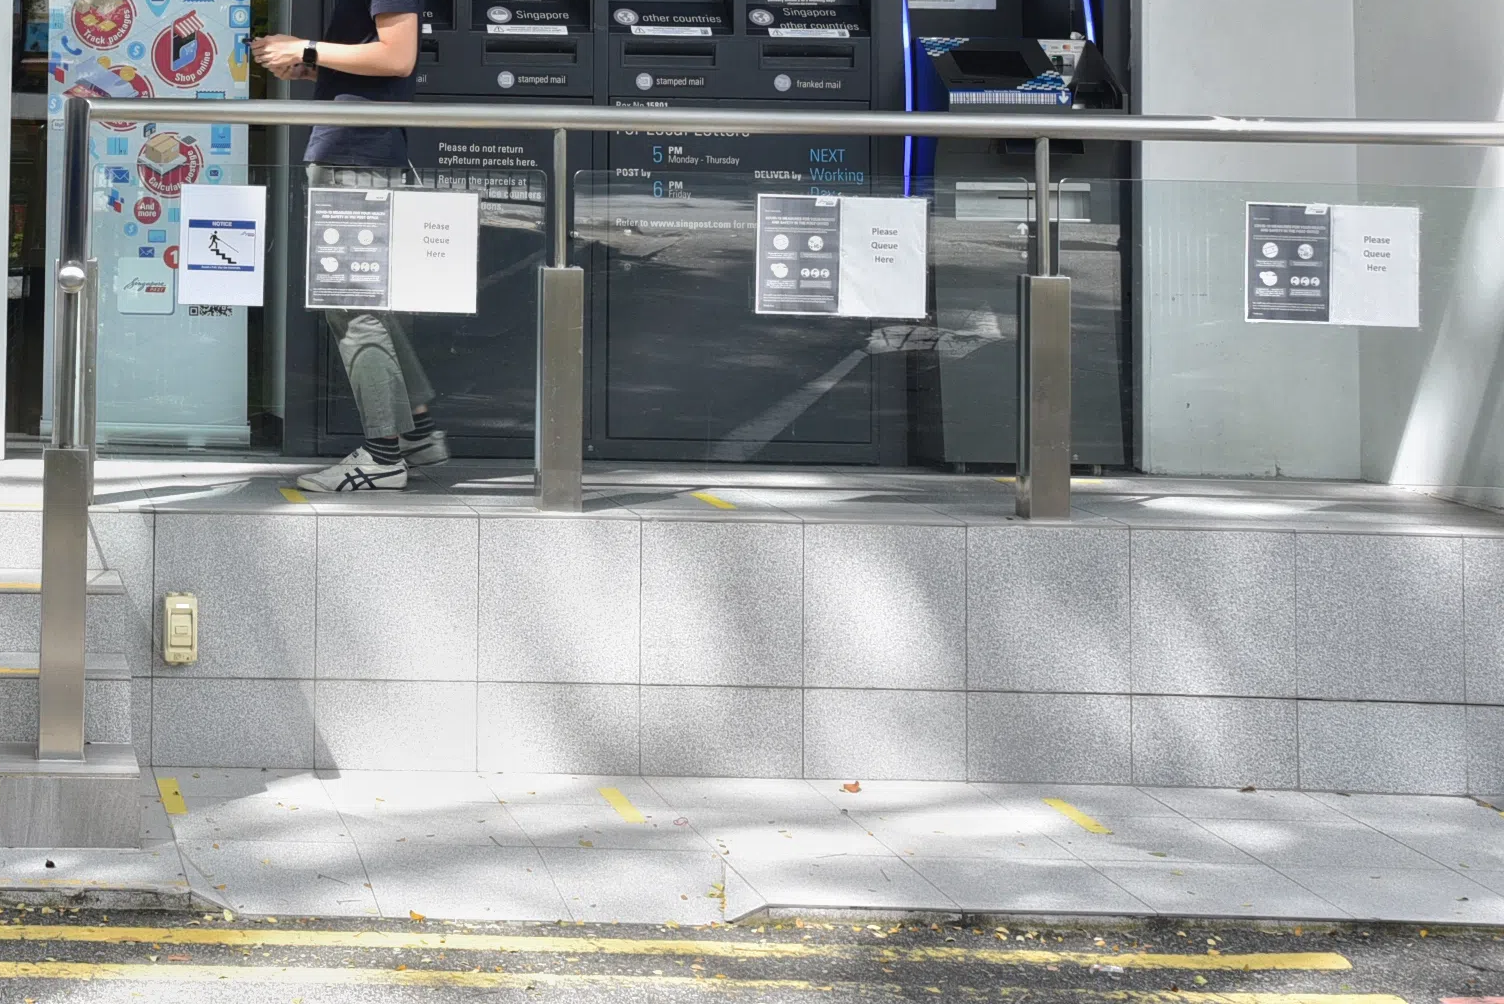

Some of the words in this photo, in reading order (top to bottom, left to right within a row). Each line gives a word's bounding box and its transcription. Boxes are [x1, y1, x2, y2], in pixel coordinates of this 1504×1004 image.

[516, 10, 570, 20] Singapore
[783, 8, 837, 18] Singapore
[643, 13, 670, 23] other
[673, 14, 722, 24] countries
[84, 28, 106, 45] Track
[108, 9, 132, 46] packages
[810, 22, 860, 31] countries
[175, 72, 196, 82] Shop
[197, 51, 211, 76] online
[416, 75, 427, 83] ail
[518, 75, 549, 85] stamped
[551, 76, 566, 84] mail
[656, 77, 687, 87] stamped
[689, 78, 704, 86] mail
[796, 80, 824, 90] franked
[826, 80, 841, 89] mail
[439, 143, 468, 152] Please
[470, 144, 480, 152] do
[482, 145, 496, 153] not
[498, 145, 524, 154] return
[653, 146, 663, 163] 5
[810, 149, 846, 163] NEXT
[438, 156, 480, 166] ezyReturn
[482, 157, 514, 167] parcels
[516, 157, 538, 167] here.
[668, 155, 699, 165] Monday
[706, 156, 740, 166] Thursday
[186, 150, 197, 184] postage
[616, 168, 639, 177] POST
[641, 169, 651, 178] by
[755, 170, 790, 179] DELIVER
[792, 171, 802, 181] by
[810, 168, 864, 185] Working
[148, 176, 183, 192] Calculat
[438, 175, 466, 184] Return
[468, 176, 482, 185] the
[484, 177, 516, 187] parcels
[518, 178, 527, 186] at
[653, 181, 663, 198] 6
[669, 181, 683, 189] PM
[669, 190, 692, 199] Friday
[504, 191, 542, 200] counters
[616, 218, 638, 227] Refer
[651, 220, 731, 230] www.singpost.com
[733, 220, 745, 228] for
[872, 228, 898, 236] Please
[424, 237, 450, 245] Queue
[1363, 236, 1391, 245] Please
[871, 242, 898, 250] Queue
[426, 250, 446, 258] Here
[1363, 250, 1391, 259] Queue
[875, 256, 894, 264] Here
[1367, 264, 1387, 272] Here
